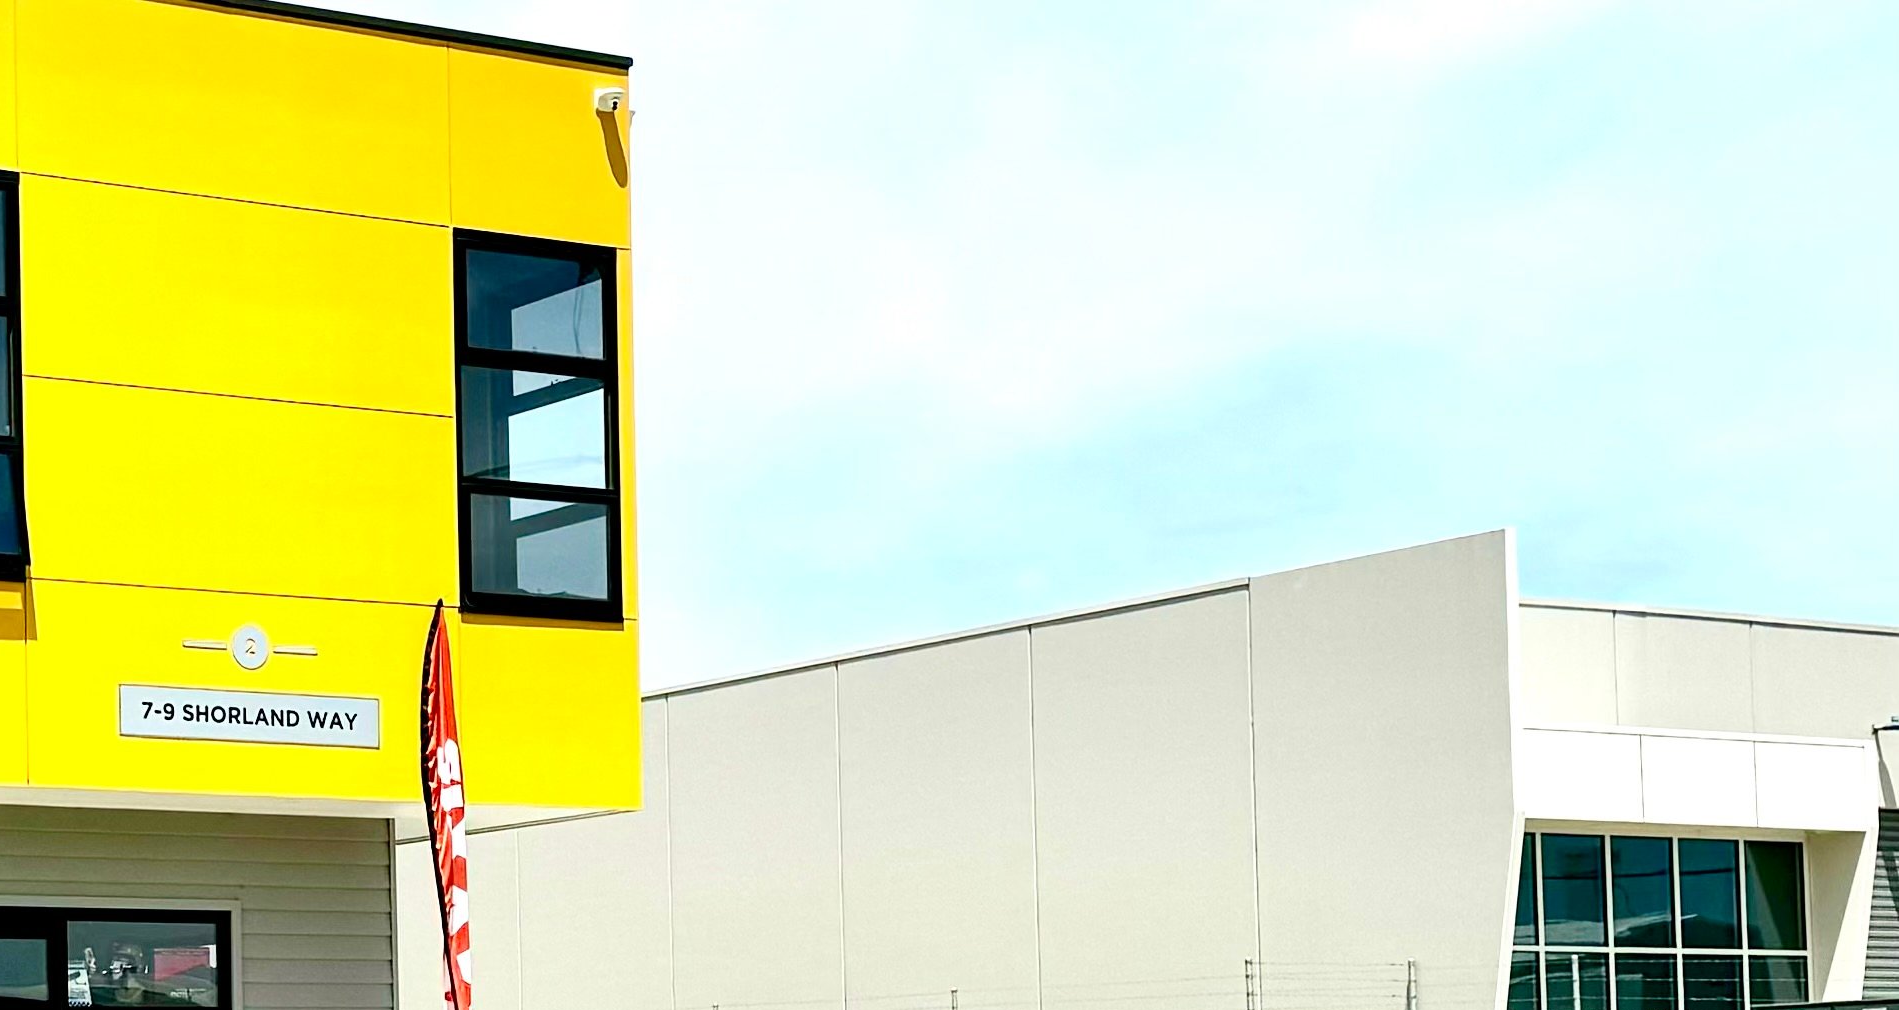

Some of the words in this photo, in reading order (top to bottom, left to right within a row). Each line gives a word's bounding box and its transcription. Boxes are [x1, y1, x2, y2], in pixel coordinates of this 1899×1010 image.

[244, 637, 256, 655] 2
[141, 701, 175, 721] 7-9
[182, 703, 300, 728] SHORLAND
[307, 710, 358, 731] WAY
